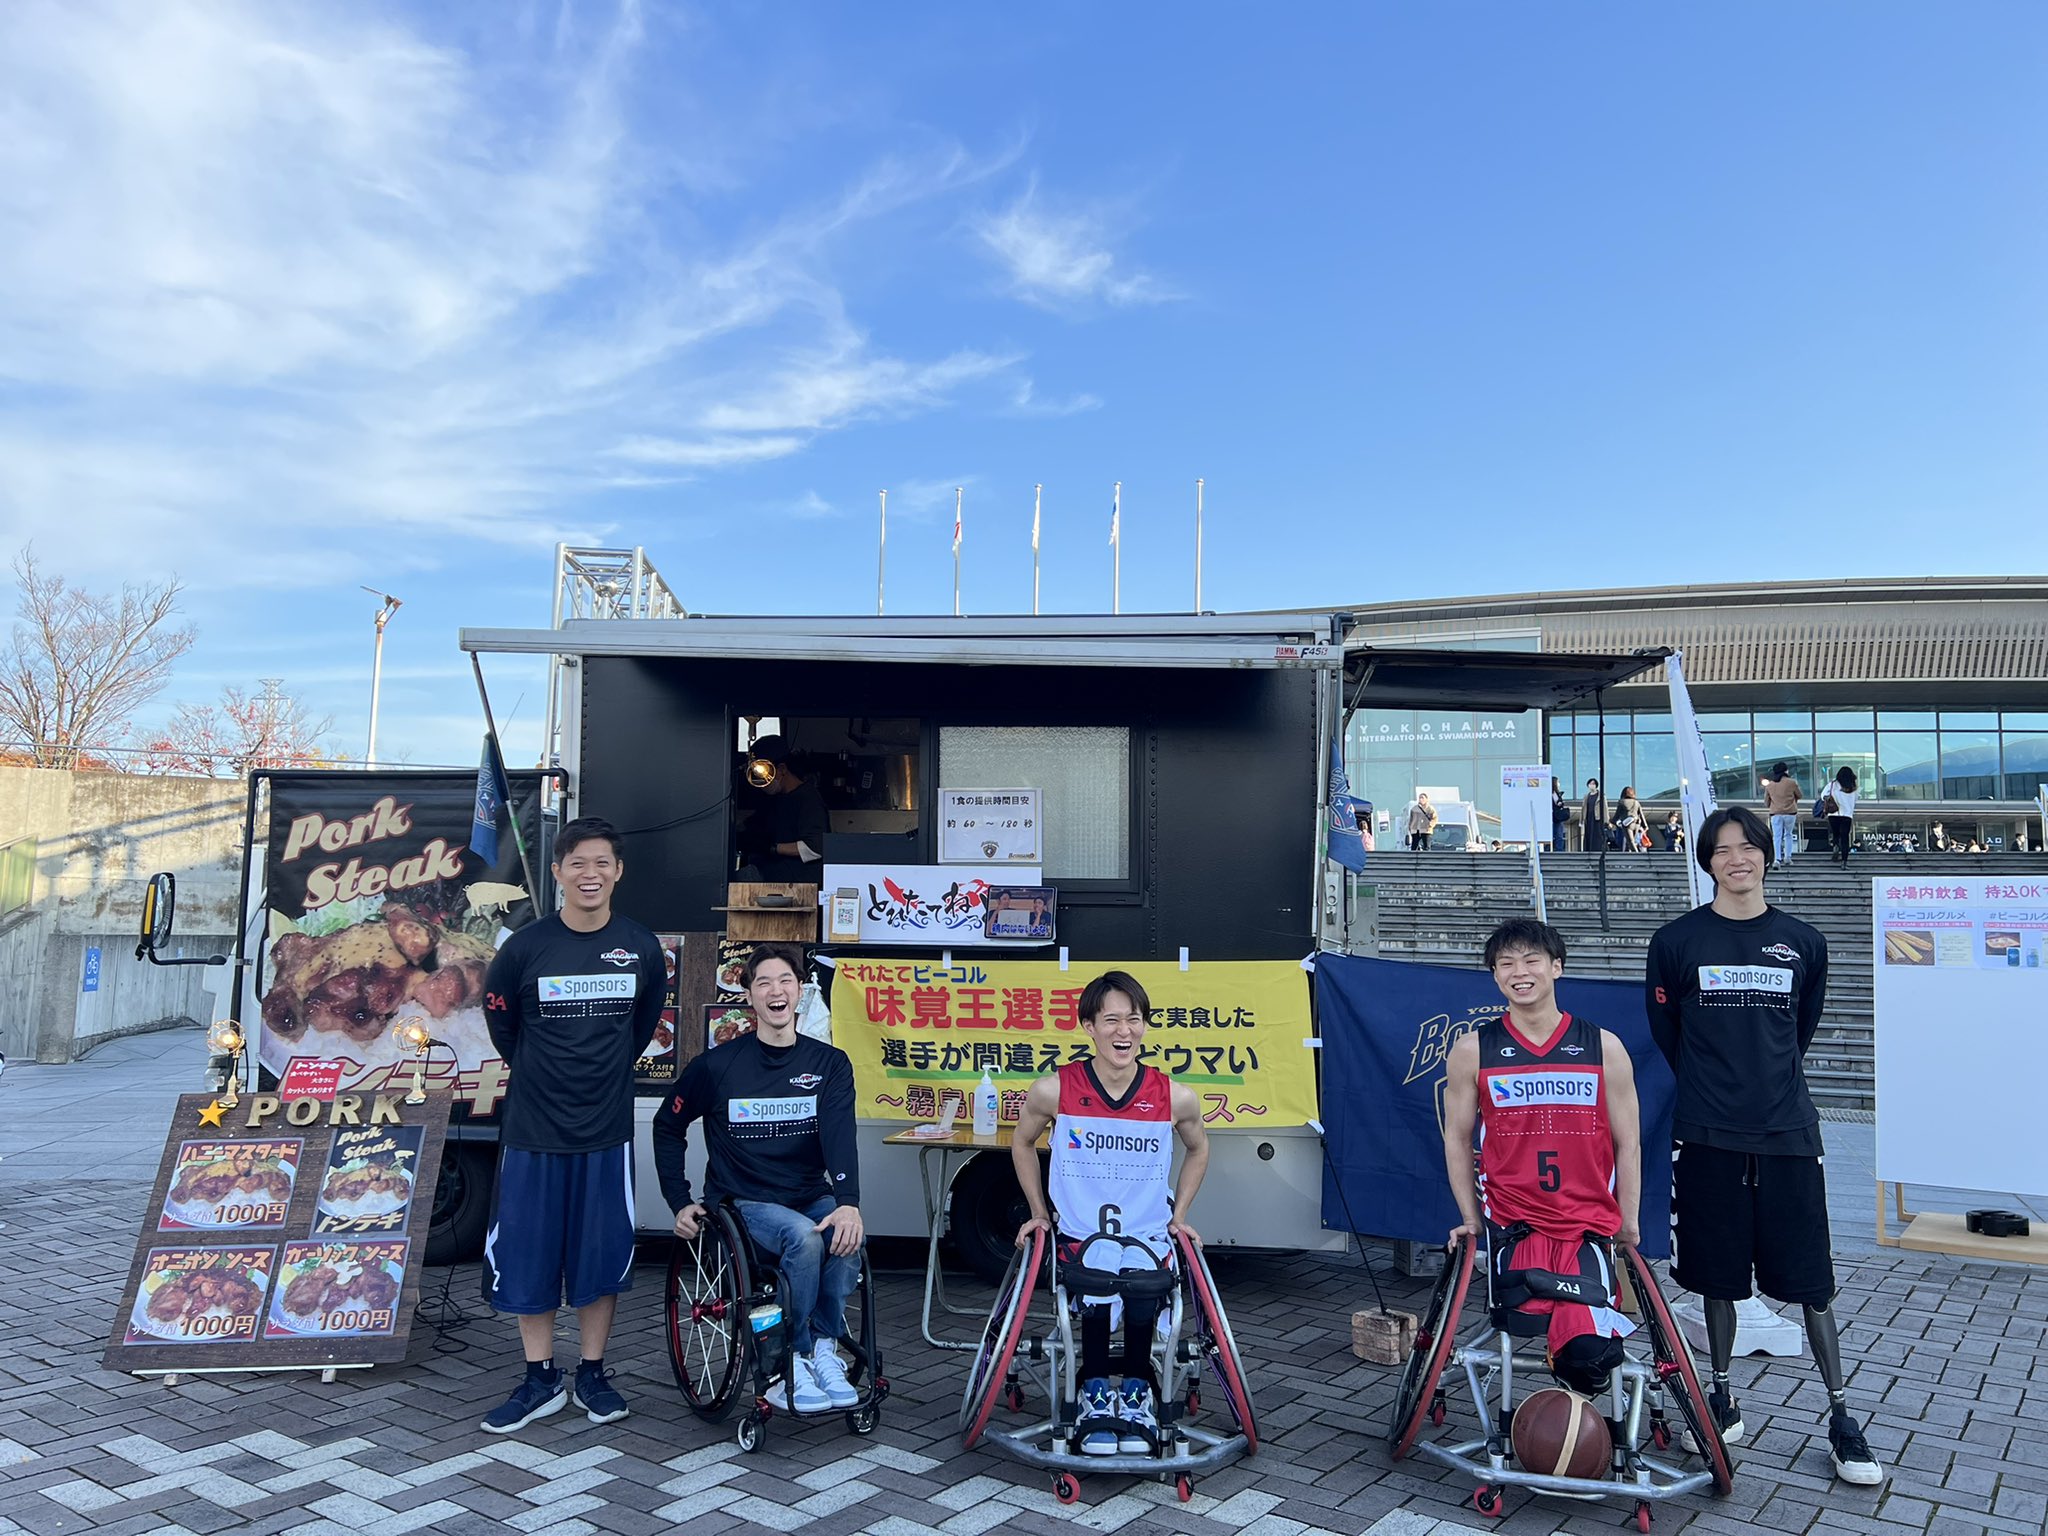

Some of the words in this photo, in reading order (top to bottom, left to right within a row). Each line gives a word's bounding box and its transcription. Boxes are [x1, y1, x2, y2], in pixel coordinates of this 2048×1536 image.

[1359, 733, 1435, 743] INTERNATIONAL
[1438, 731, 1488, 740] SWIMMING
[1360, 720, 1516, 734] YOKOHAMA
[952, 796, 1029, 806] 1食の提供時間目安
[282, 796, 414, 862] Pork
[963, 819, 976, 828] 60
[302, 838, 465, 908] Steak
[1886, 886, 1968, 899] 会場内飲食
[841, 963, 987, 984] とれたてビーコル
[1723, 970, 1783, 987] Sponsors
[564, 980, 627, 997] Sponsors
[486, 992, 507, 1011] 34
[1513, 1080, 1593, 1102] Sponsors
[245, 1093, 406, 1128] PORK
[752, 1101, 811, 1119] Sponsors
[336, 1126, 385, 1146] Pork
[1085, 1131, 1160, 1154] Sponsors
[181, 1143, 298, 1162] ハニーマスタード
[341, 1138, 397, 1160] Steak
[1537, 1151, 1561, 1192] 5
[214, 1203, 288, 1223] 1000円
[315, 1212, 404, 1233] トンテキ
[1099, 1203, 1121, 1236] 6
[150, 1252, 220, 1270] オニオン
[225, 1251, 270, 1269] ソース
[285, 1246, 359, 1263] ガーリック
[365, 1244, 405, 1261] ソース
[1556, 1280, 1581, 1296] FIX
[180, 1315, 255, 1336] 1000円
[318, 1309, 391, 1330] 1000円
